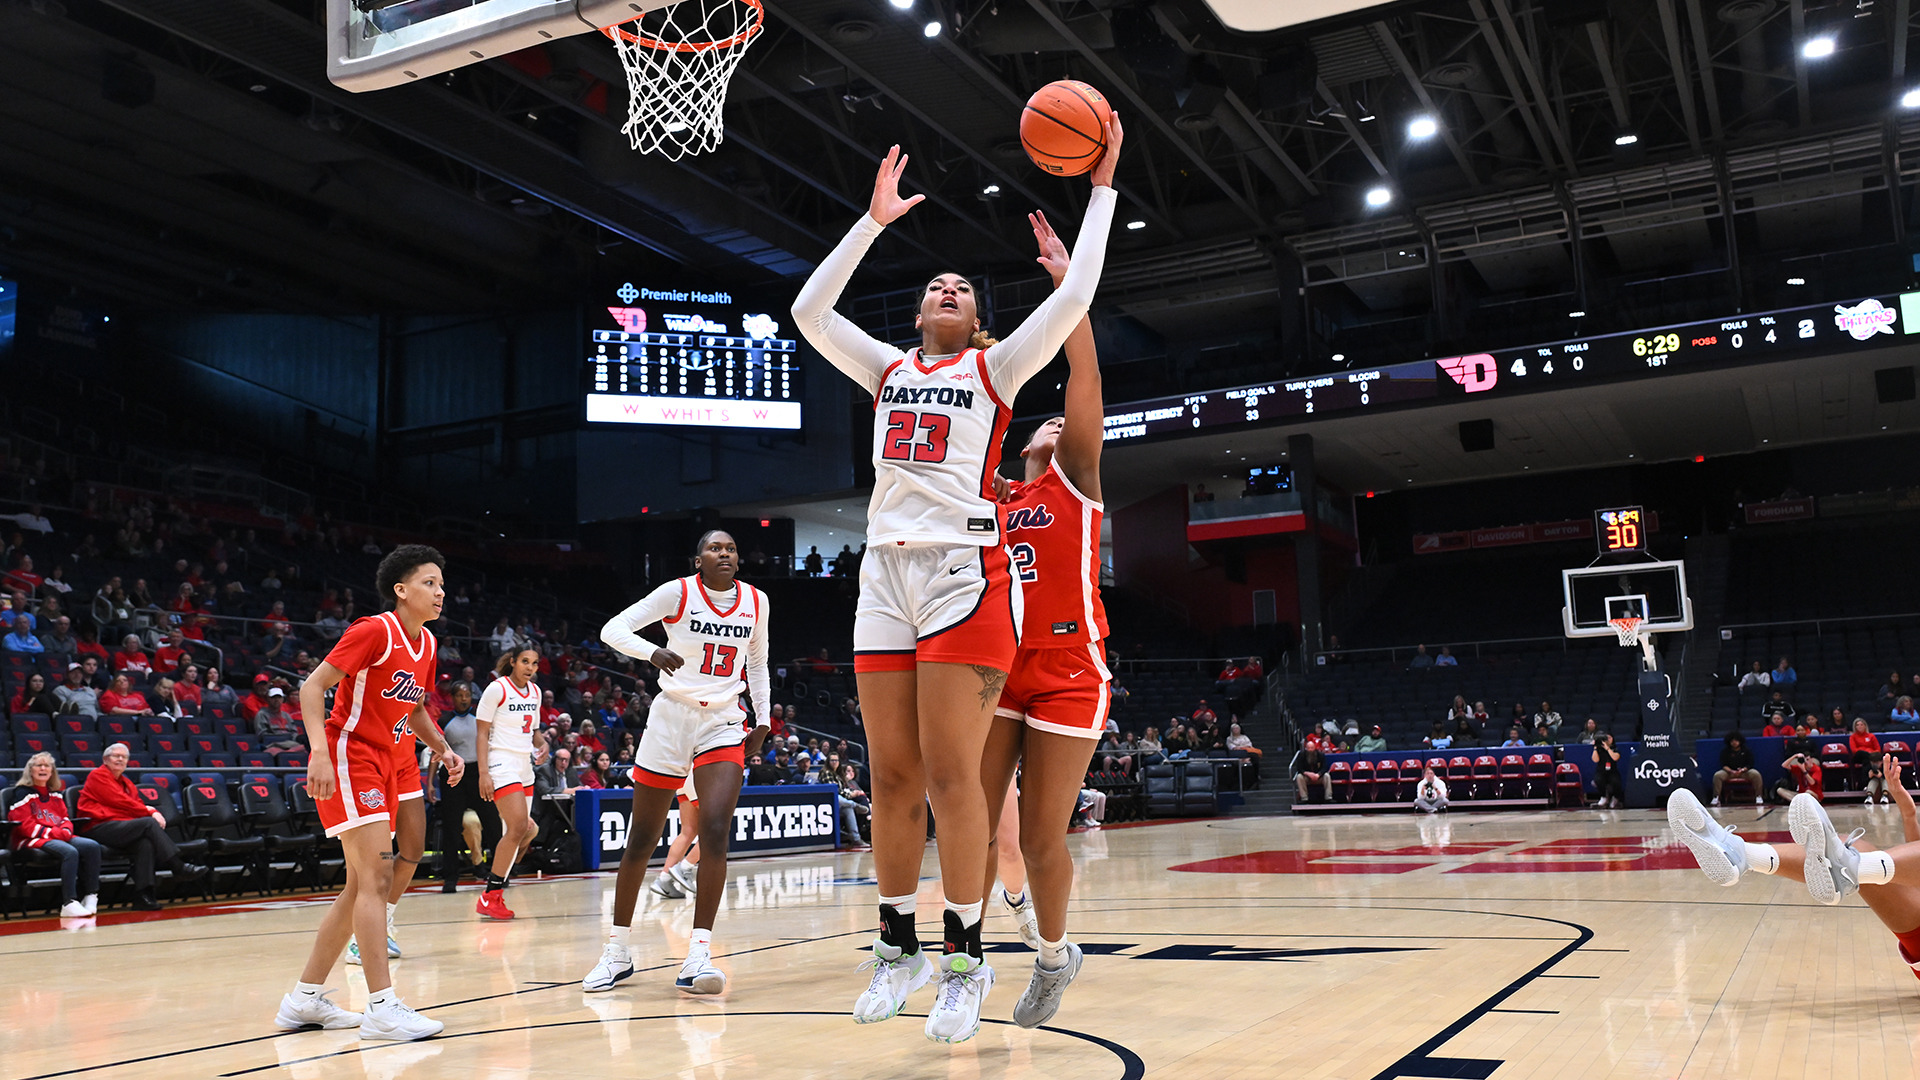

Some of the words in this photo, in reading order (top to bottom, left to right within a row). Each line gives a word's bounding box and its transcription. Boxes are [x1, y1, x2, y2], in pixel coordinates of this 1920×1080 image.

[641, 288, 689, 302] Premier
[691, 290, 732, 304] Health
[1721, 320, 1748, 332] FOULS
[1759, 316, 1776, 326] TOL
[1731, 333, 1743, 349] 0
[1764, 329, 1777, 344] 4
[1798, 318, 1816, 339] 2
[1632, 332, 1681, 357] 6:29
[1691, 336, 1718, 347] POSS
[1537, 348, 1553, 357] TOL
[1564, 343, 1589, 353] FOULS
[1510, 358, 1528, 377] 4
[1543, 359, 1554, 375] 4
[1572, 355, 1584, 371] 0
[1646, 354, 1668, 367] 1ST
[1348, 370, 1381, 383] BLOCKS
[1284, 381, 1307, 392] TURN
[1307, 377, 1334, 389] OVERS
[1360, 381, 1369, 392] 0
[881, 385, 974, 410] DAYTON
[1225, 389, 1247, 400] FIELD
[1247, 387, 1268, 398] GOAL
[1304, 388, 1313, 399] 3
[1360, 393, 1370, 405] 0
[1191, 403, 1200, 414] 0
[1244, 396, 1259, 408] 20
[1305, 401, 1314, 413] 2
[622, 403, 640, 415] W
[752, 408, 769, 421] W
[1103, 411, 1144, 427] ETROIT
[1245, 409, 1260, 421] 33
[1192, 417, 1201, 428] 0
[882, 410, 951, 464] 23
[1006, 503, 1055, 533] ans
[1608, 510, 1640, 526] 6:29
[1754, 505, 1805, 518] FORDHAM
[1477, 530, 1526, 544] DAVIDSON
[1544, 526, 1580, 537] DAYTON
[1606, 524, 1638, 549] 30
[689, 619, 753, 639] DAYTON
[699, 642, 738, 678] 13
[508, 703, 537, 712] DAYTO
[1643, 733, 1670, 741] Premier
[1634, 760, 1687, 787] Kroger
[733, 803, 834, 841] FLYERS
